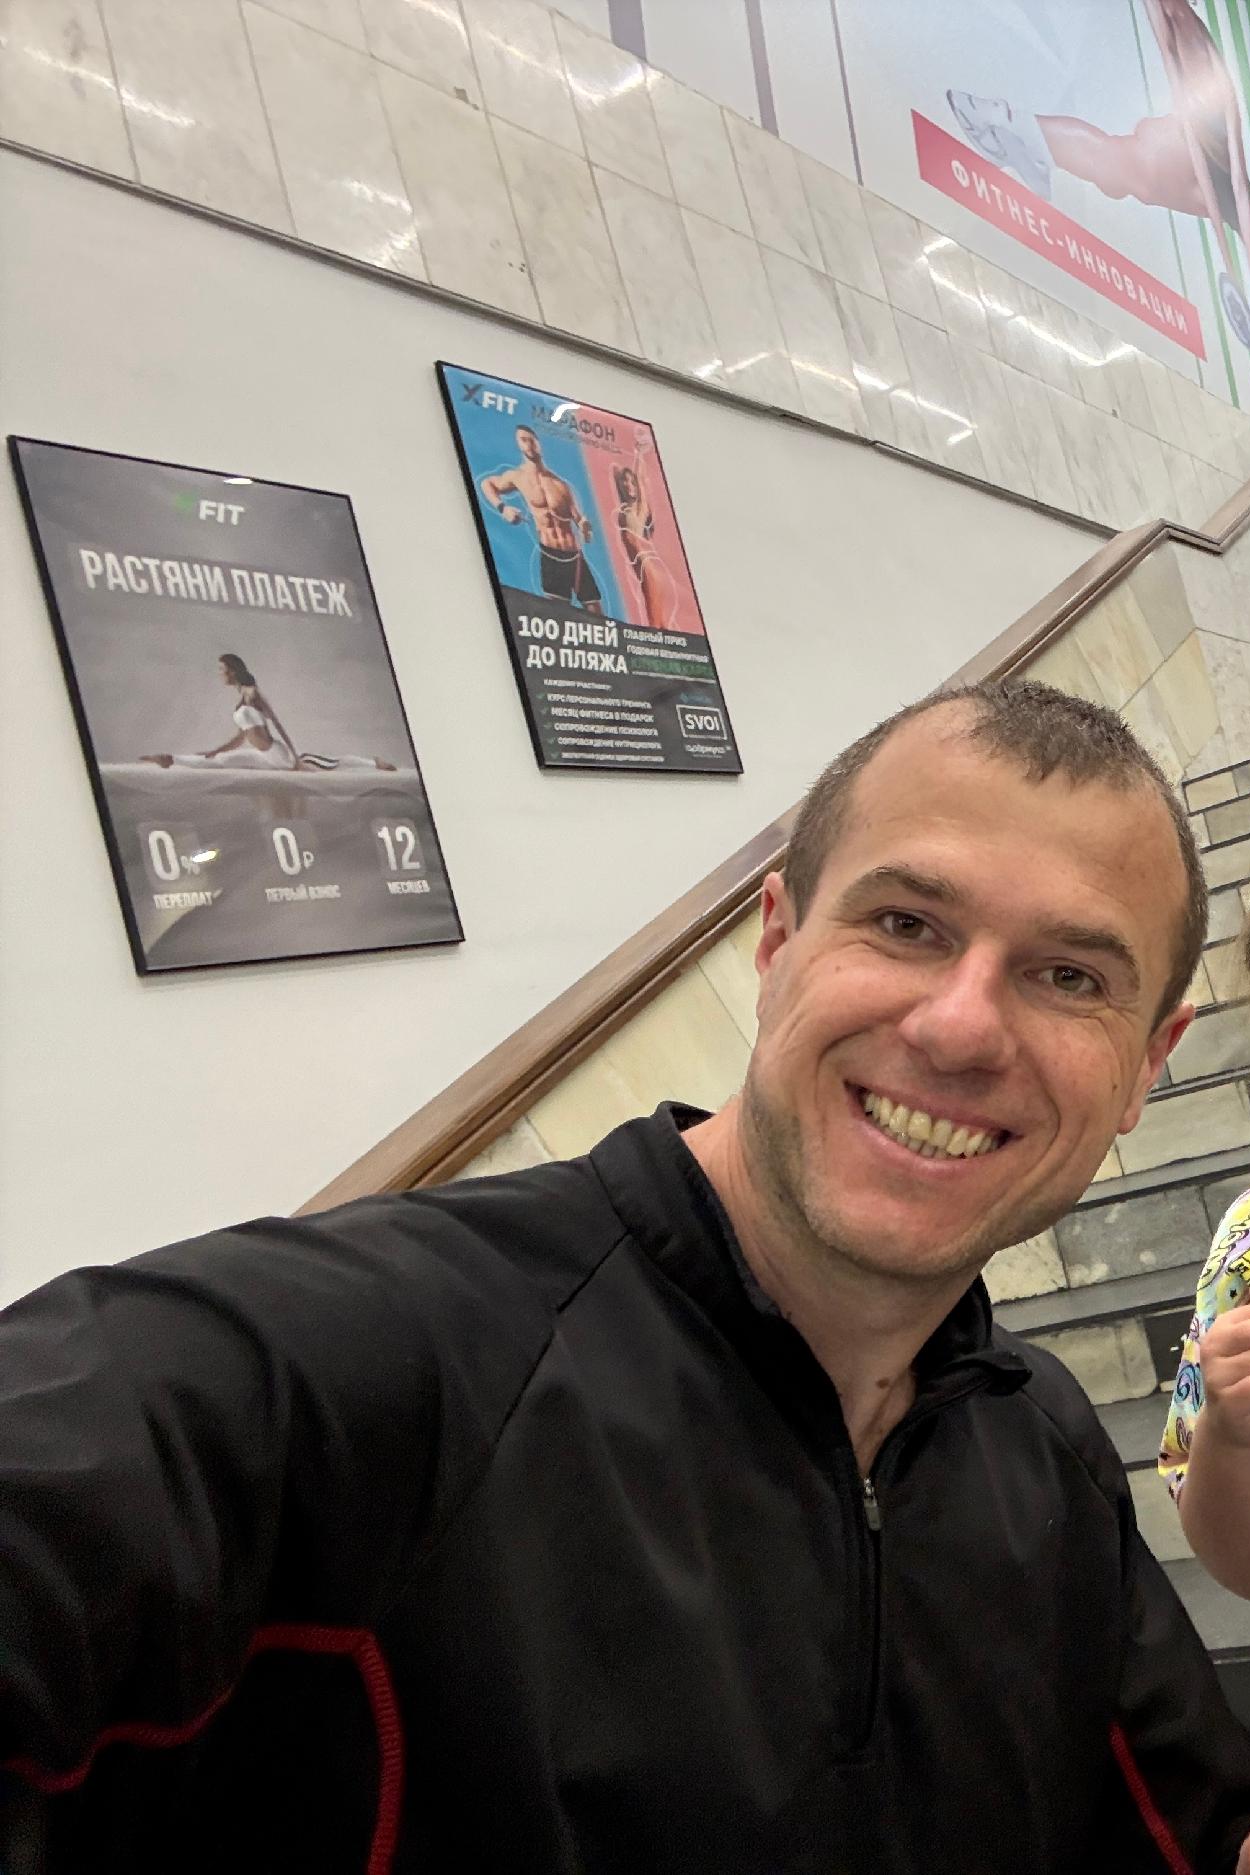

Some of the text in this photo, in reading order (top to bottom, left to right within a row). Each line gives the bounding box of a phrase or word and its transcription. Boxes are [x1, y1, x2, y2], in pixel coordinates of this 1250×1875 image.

[951, 159, 1189, 335] ФИТНЕС-ИННОВАЦИИ
[79, 549, 353, 617] РАСТЯНИ ПЛАТЕЖ
[518, 615, 619, 648] 100 ДНЕЙ
[526, 644, 557, 669] ДО
[559, 648, 629, 674] ПЛЯЖА
[377, 826, 421, 872] 12
